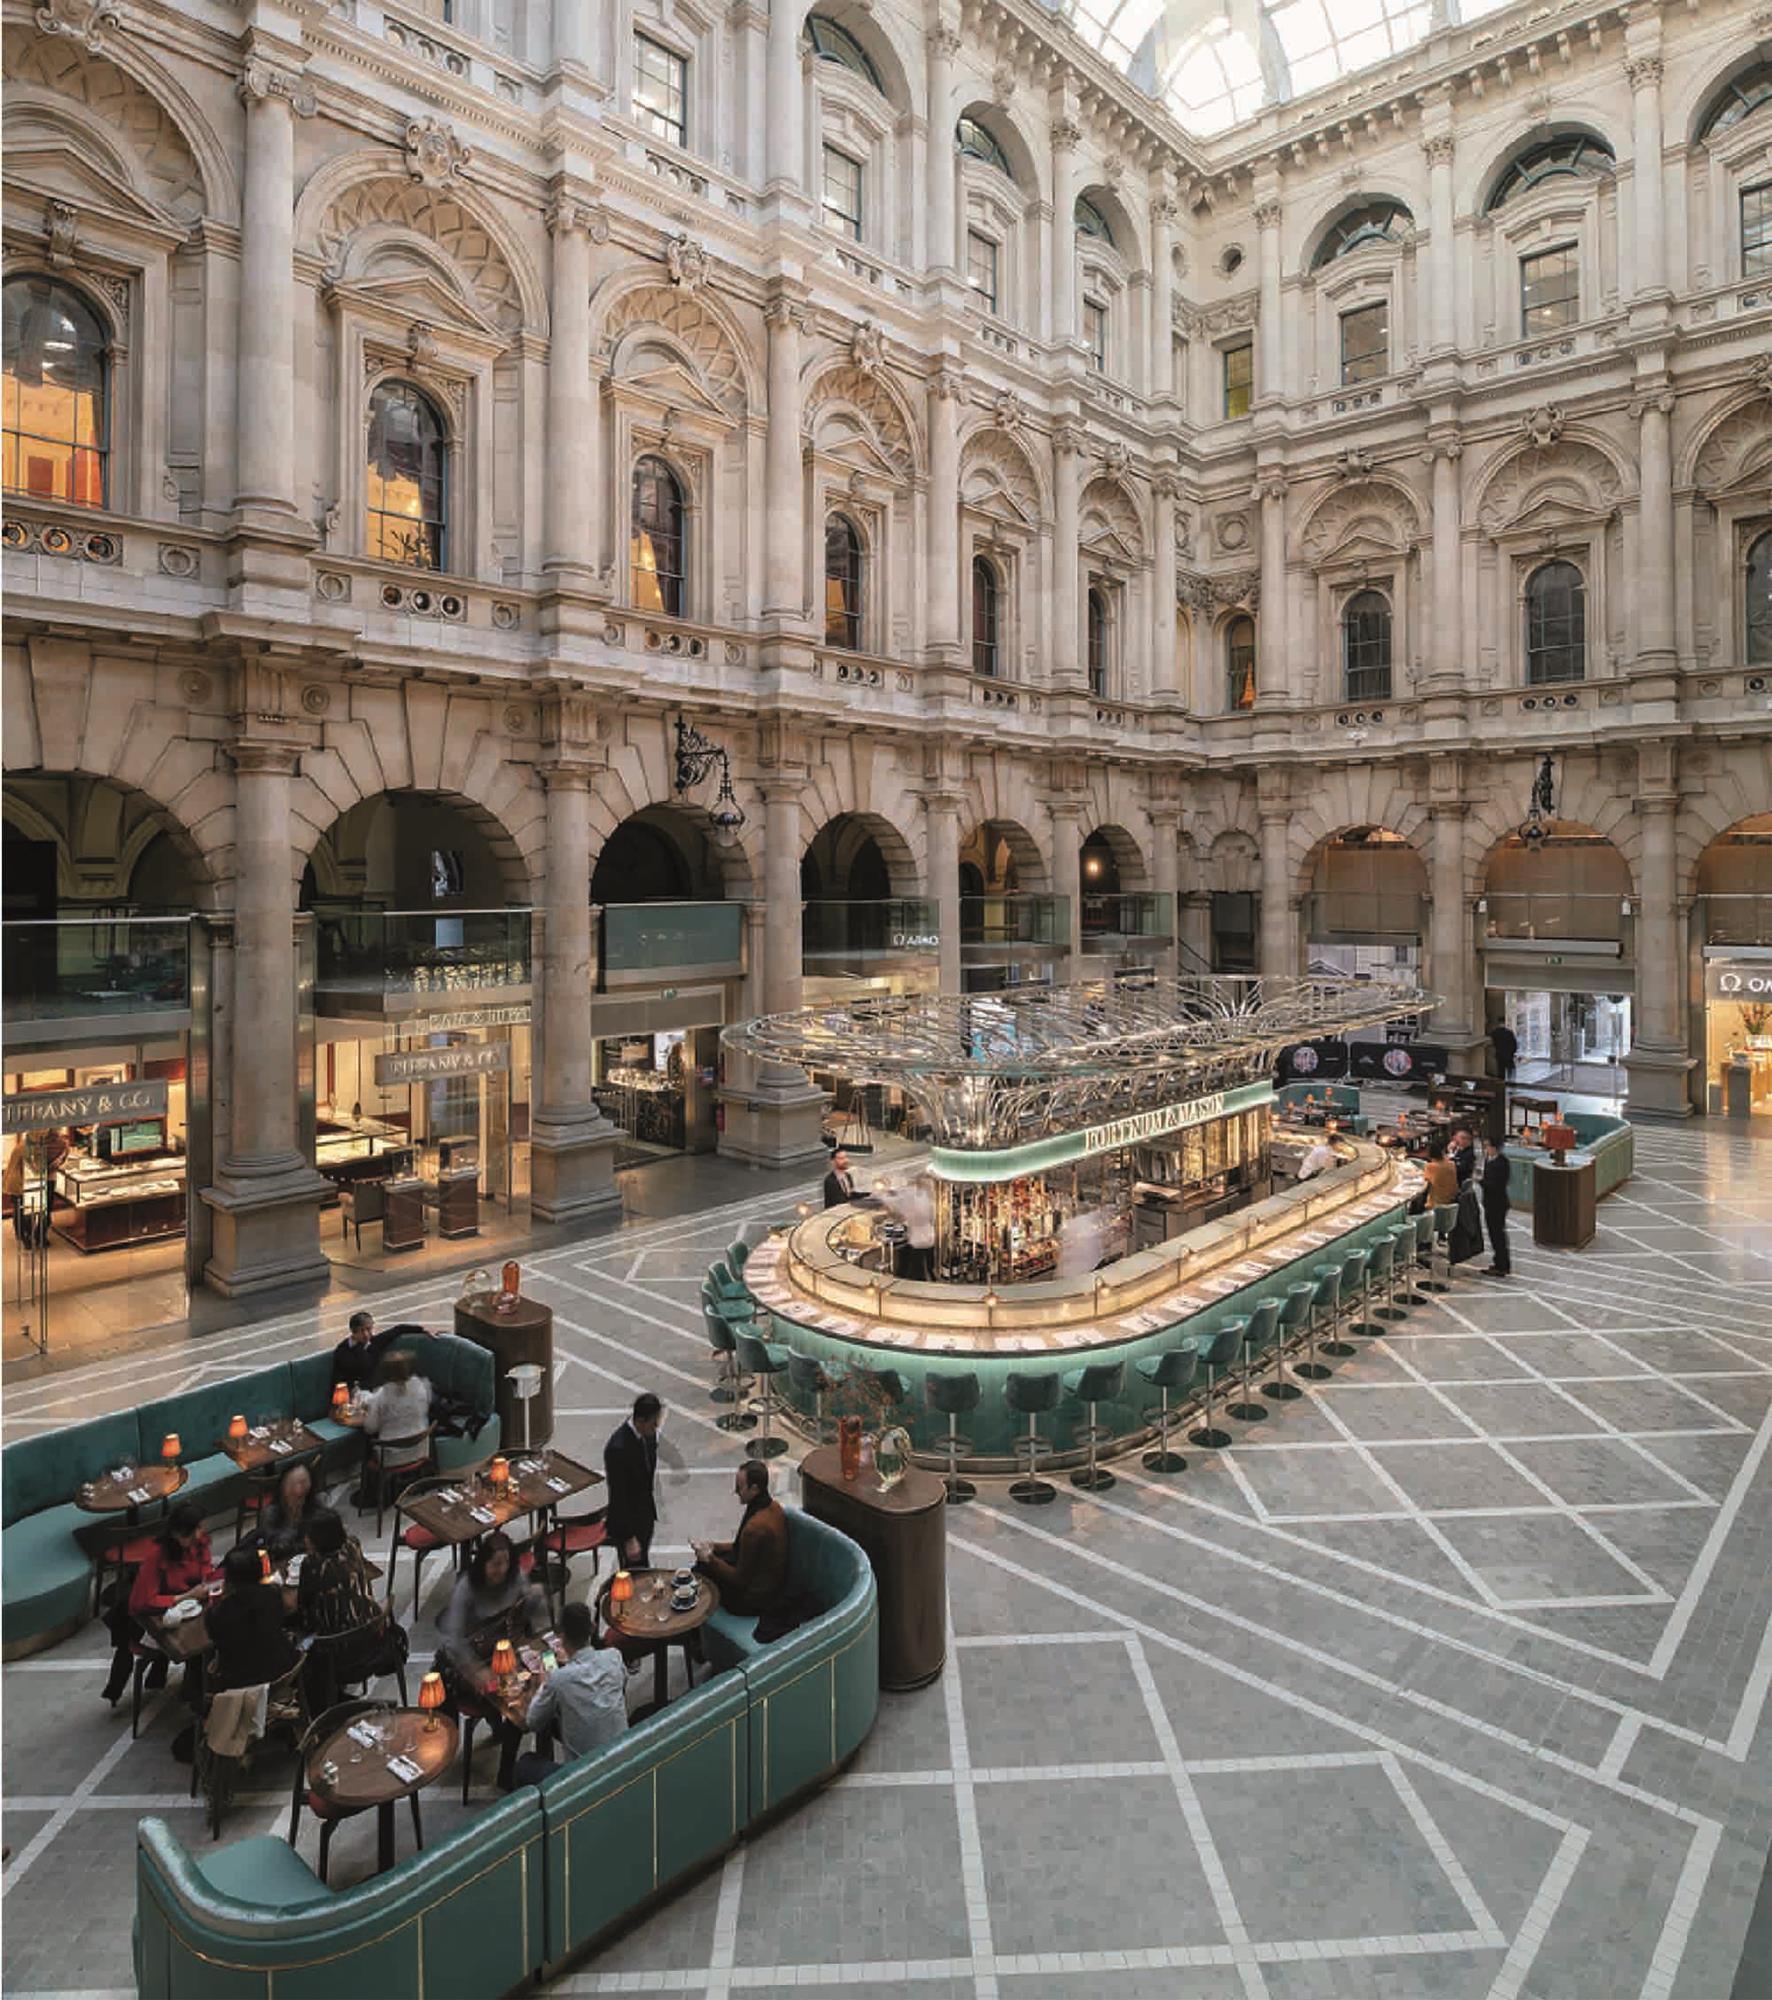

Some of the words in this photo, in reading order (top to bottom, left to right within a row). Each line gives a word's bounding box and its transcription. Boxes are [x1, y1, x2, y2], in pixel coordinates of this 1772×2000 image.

[98, 1095, 113, 1114] &
[1085, 1110, 1163, 1153] FORTNUM
[1165, 1107, 1179, 1129] &
[1179, 1092, 1225, 1122] MASON
